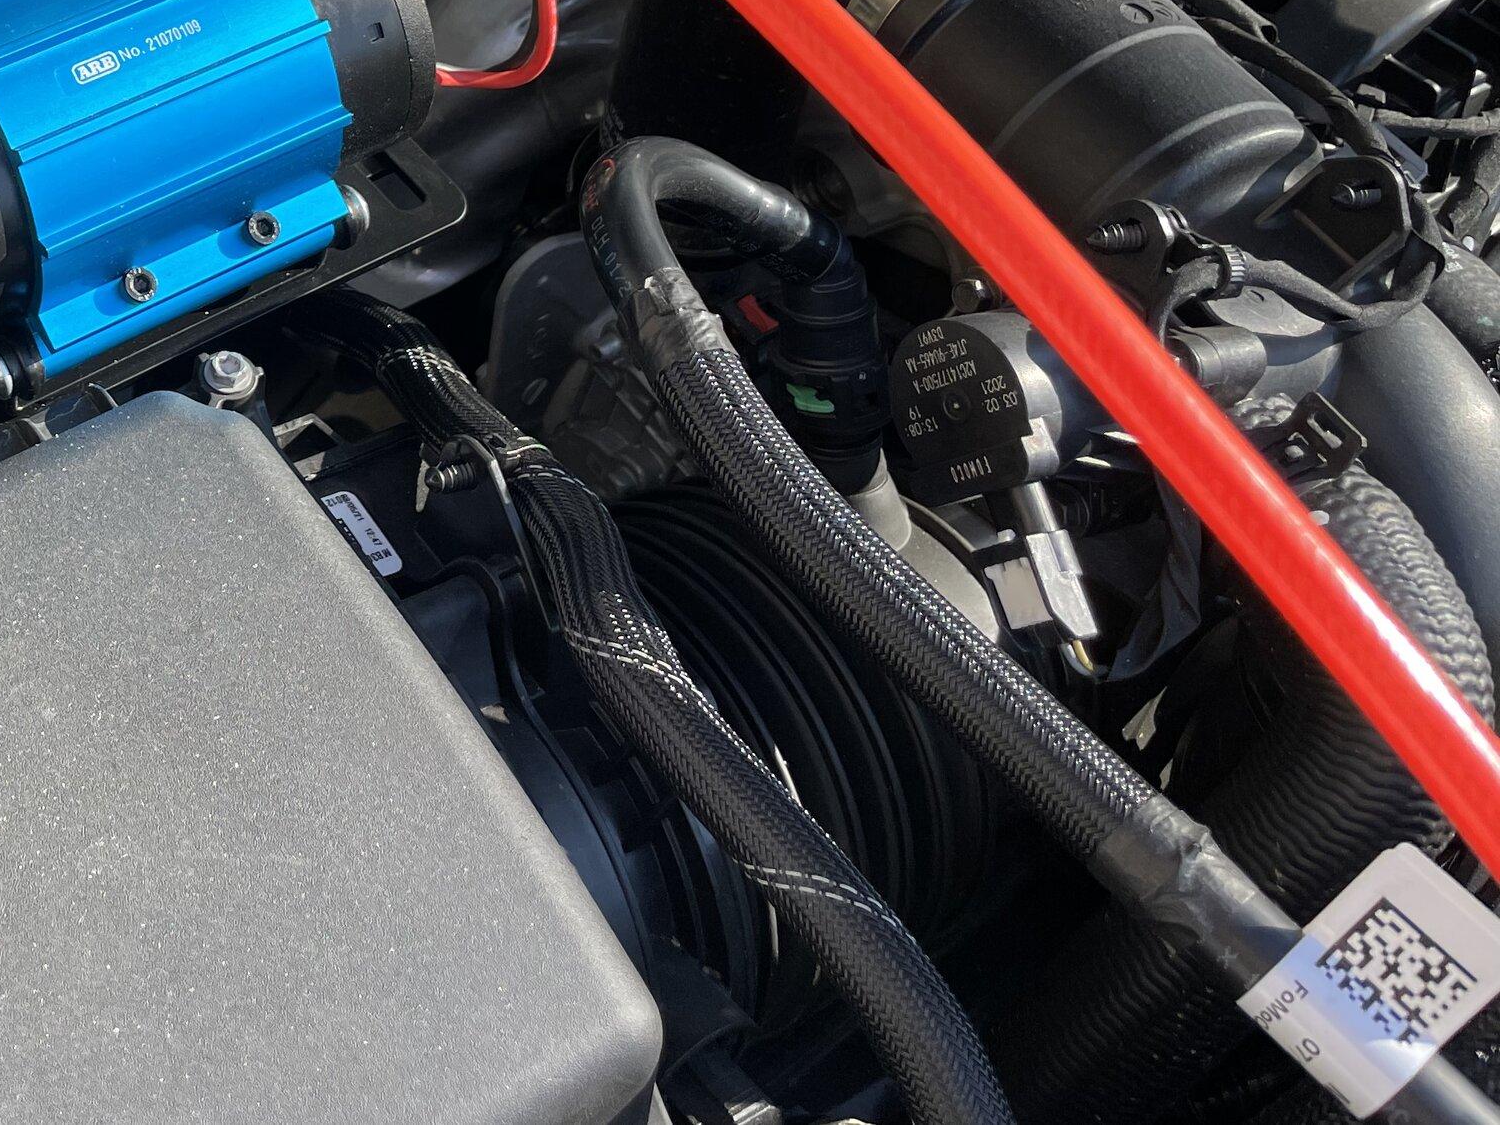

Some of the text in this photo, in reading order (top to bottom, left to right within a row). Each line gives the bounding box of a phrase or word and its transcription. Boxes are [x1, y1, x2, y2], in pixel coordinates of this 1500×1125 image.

[77, 19, 202, 80] ARB No. 21070109
[981, 375, 1007, 395] 2021
[909, 405, 922, 420] 19
